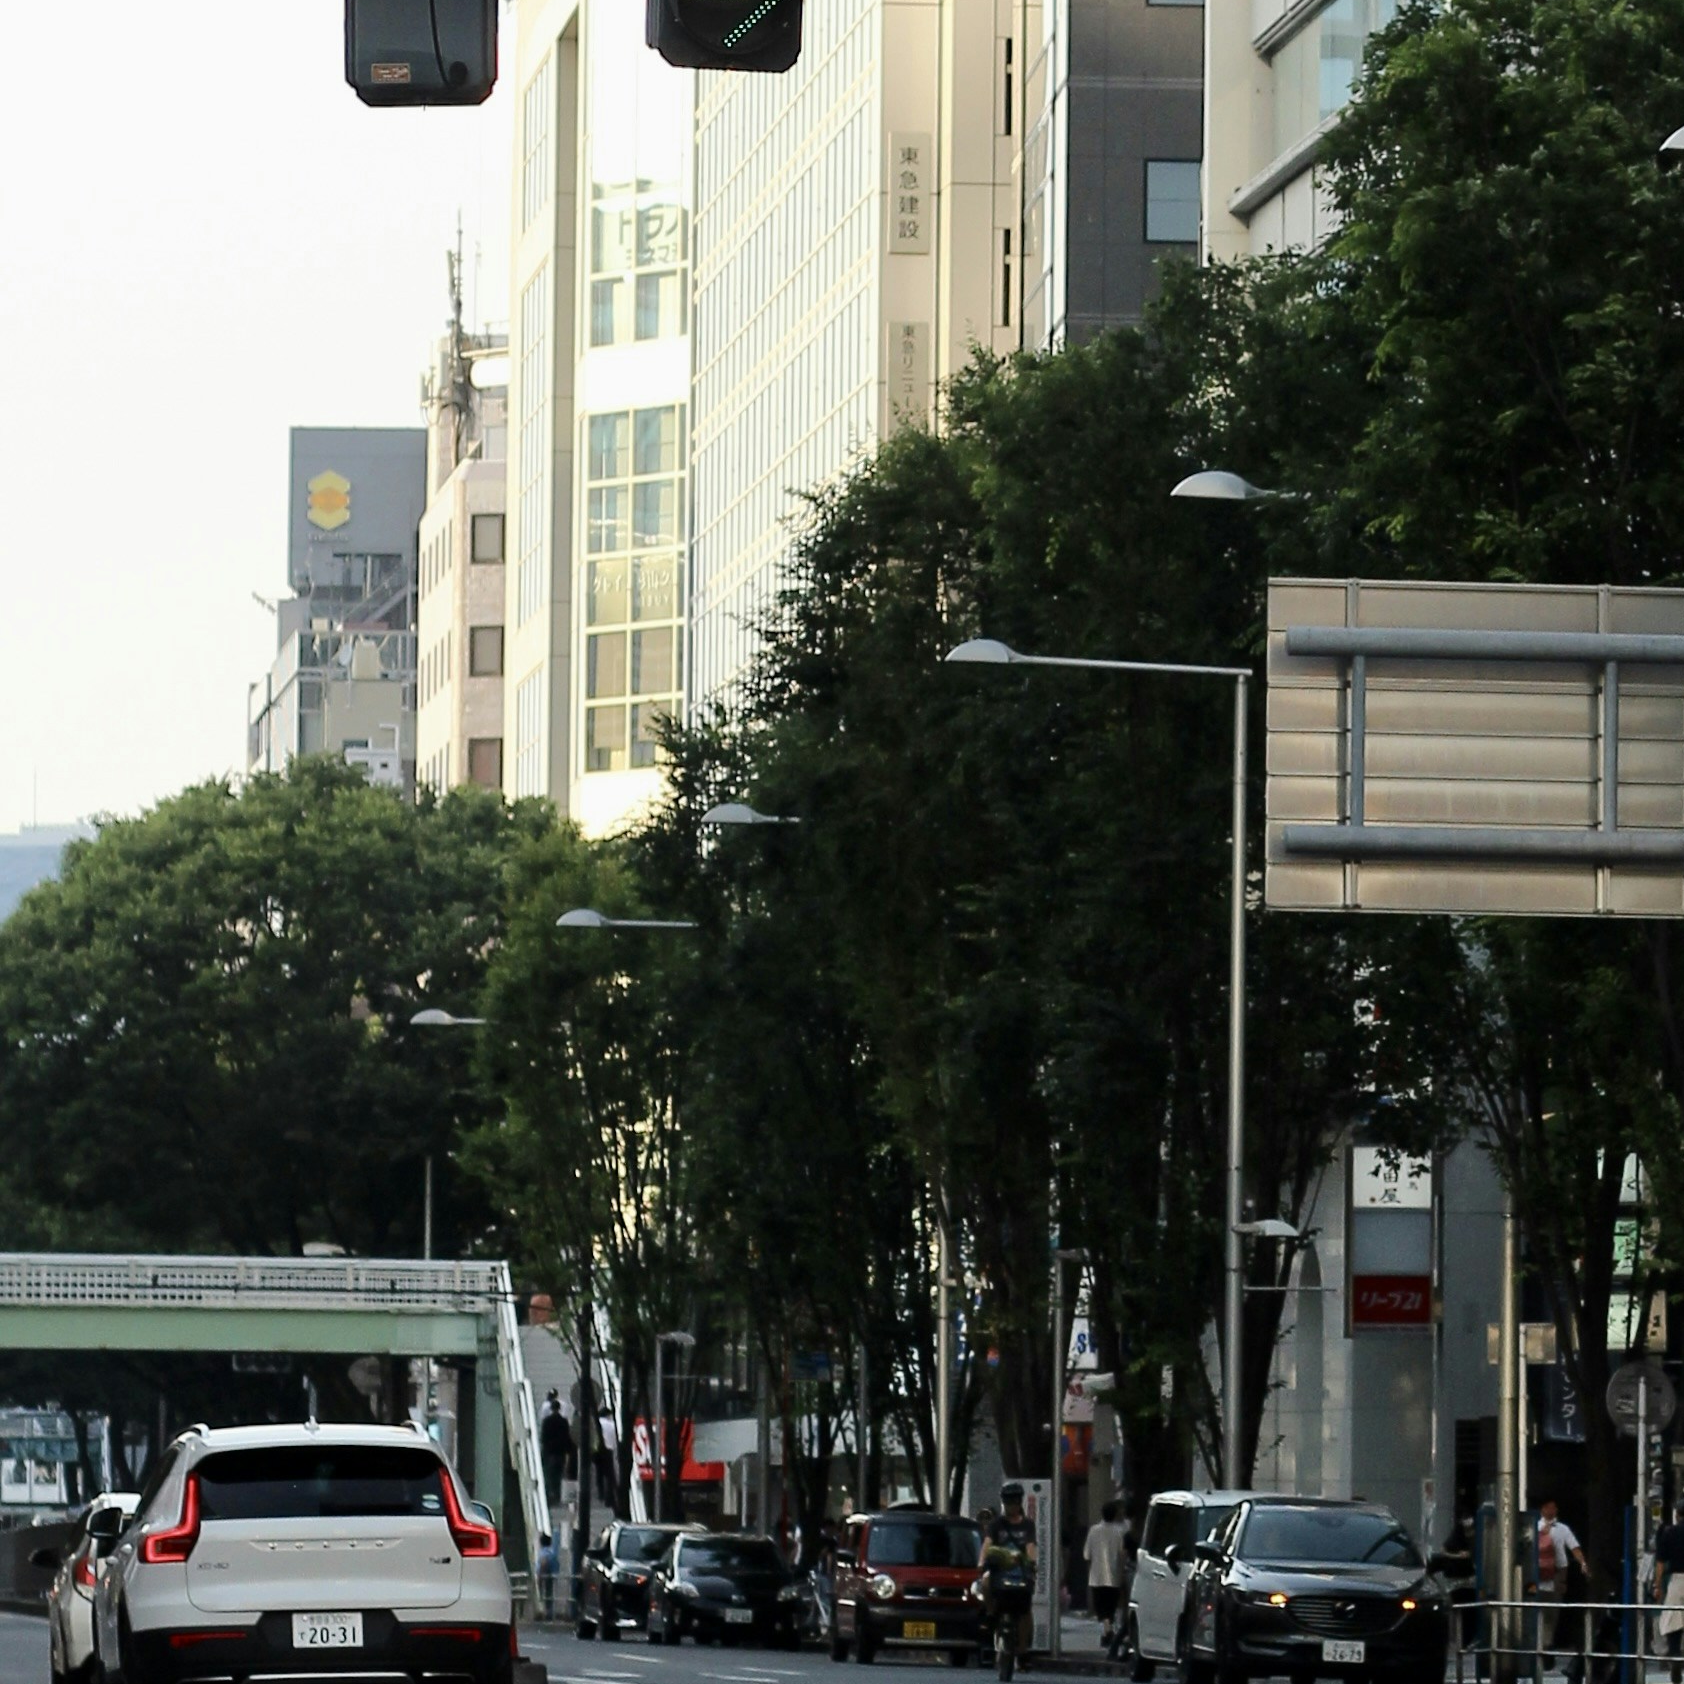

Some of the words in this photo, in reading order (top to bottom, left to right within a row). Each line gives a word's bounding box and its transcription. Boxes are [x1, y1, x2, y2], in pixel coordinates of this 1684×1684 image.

[899, 146, 919, 240] 東急建設
[309, 1627, 356, 1644] 20-31
